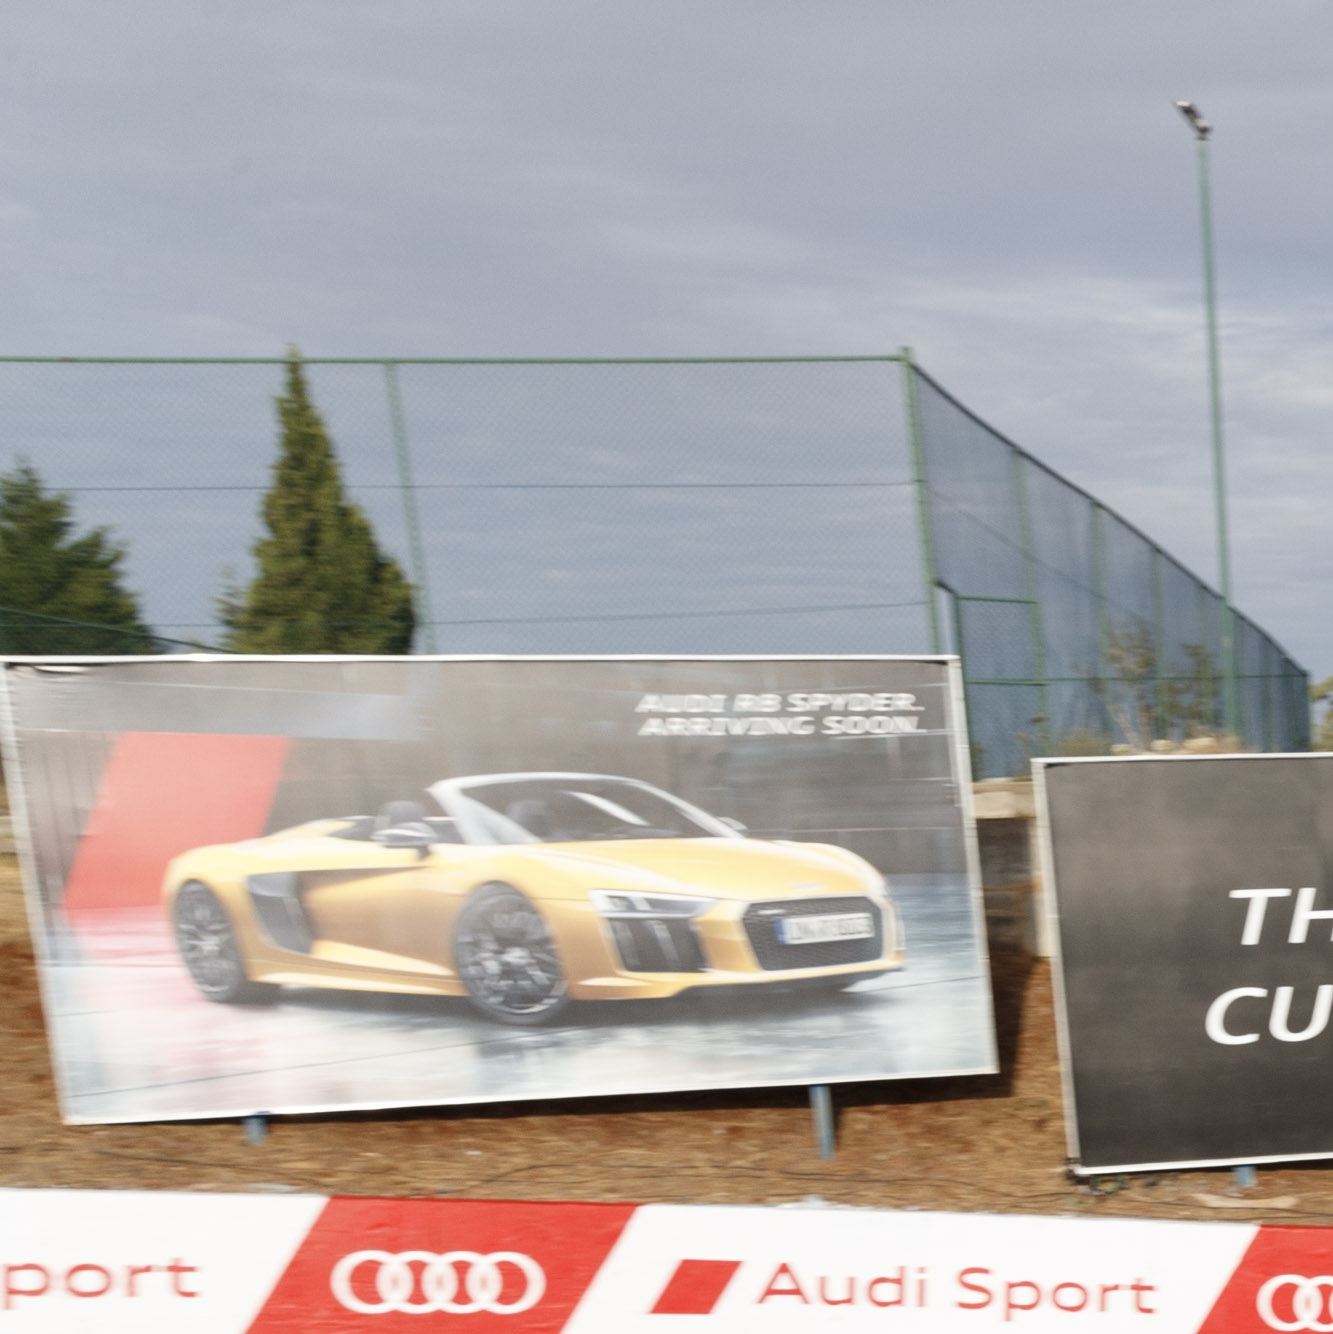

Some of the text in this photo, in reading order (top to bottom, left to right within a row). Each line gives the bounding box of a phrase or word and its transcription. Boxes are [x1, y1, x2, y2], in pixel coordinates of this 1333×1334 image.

[634, 693, 728, 713] AUDI
[785, 692, 926, 712] SPYDER.
[636, 715, 928, 737] ARRIVING SOON.
[756, 1261, 1162, 1323] Audi Sport
